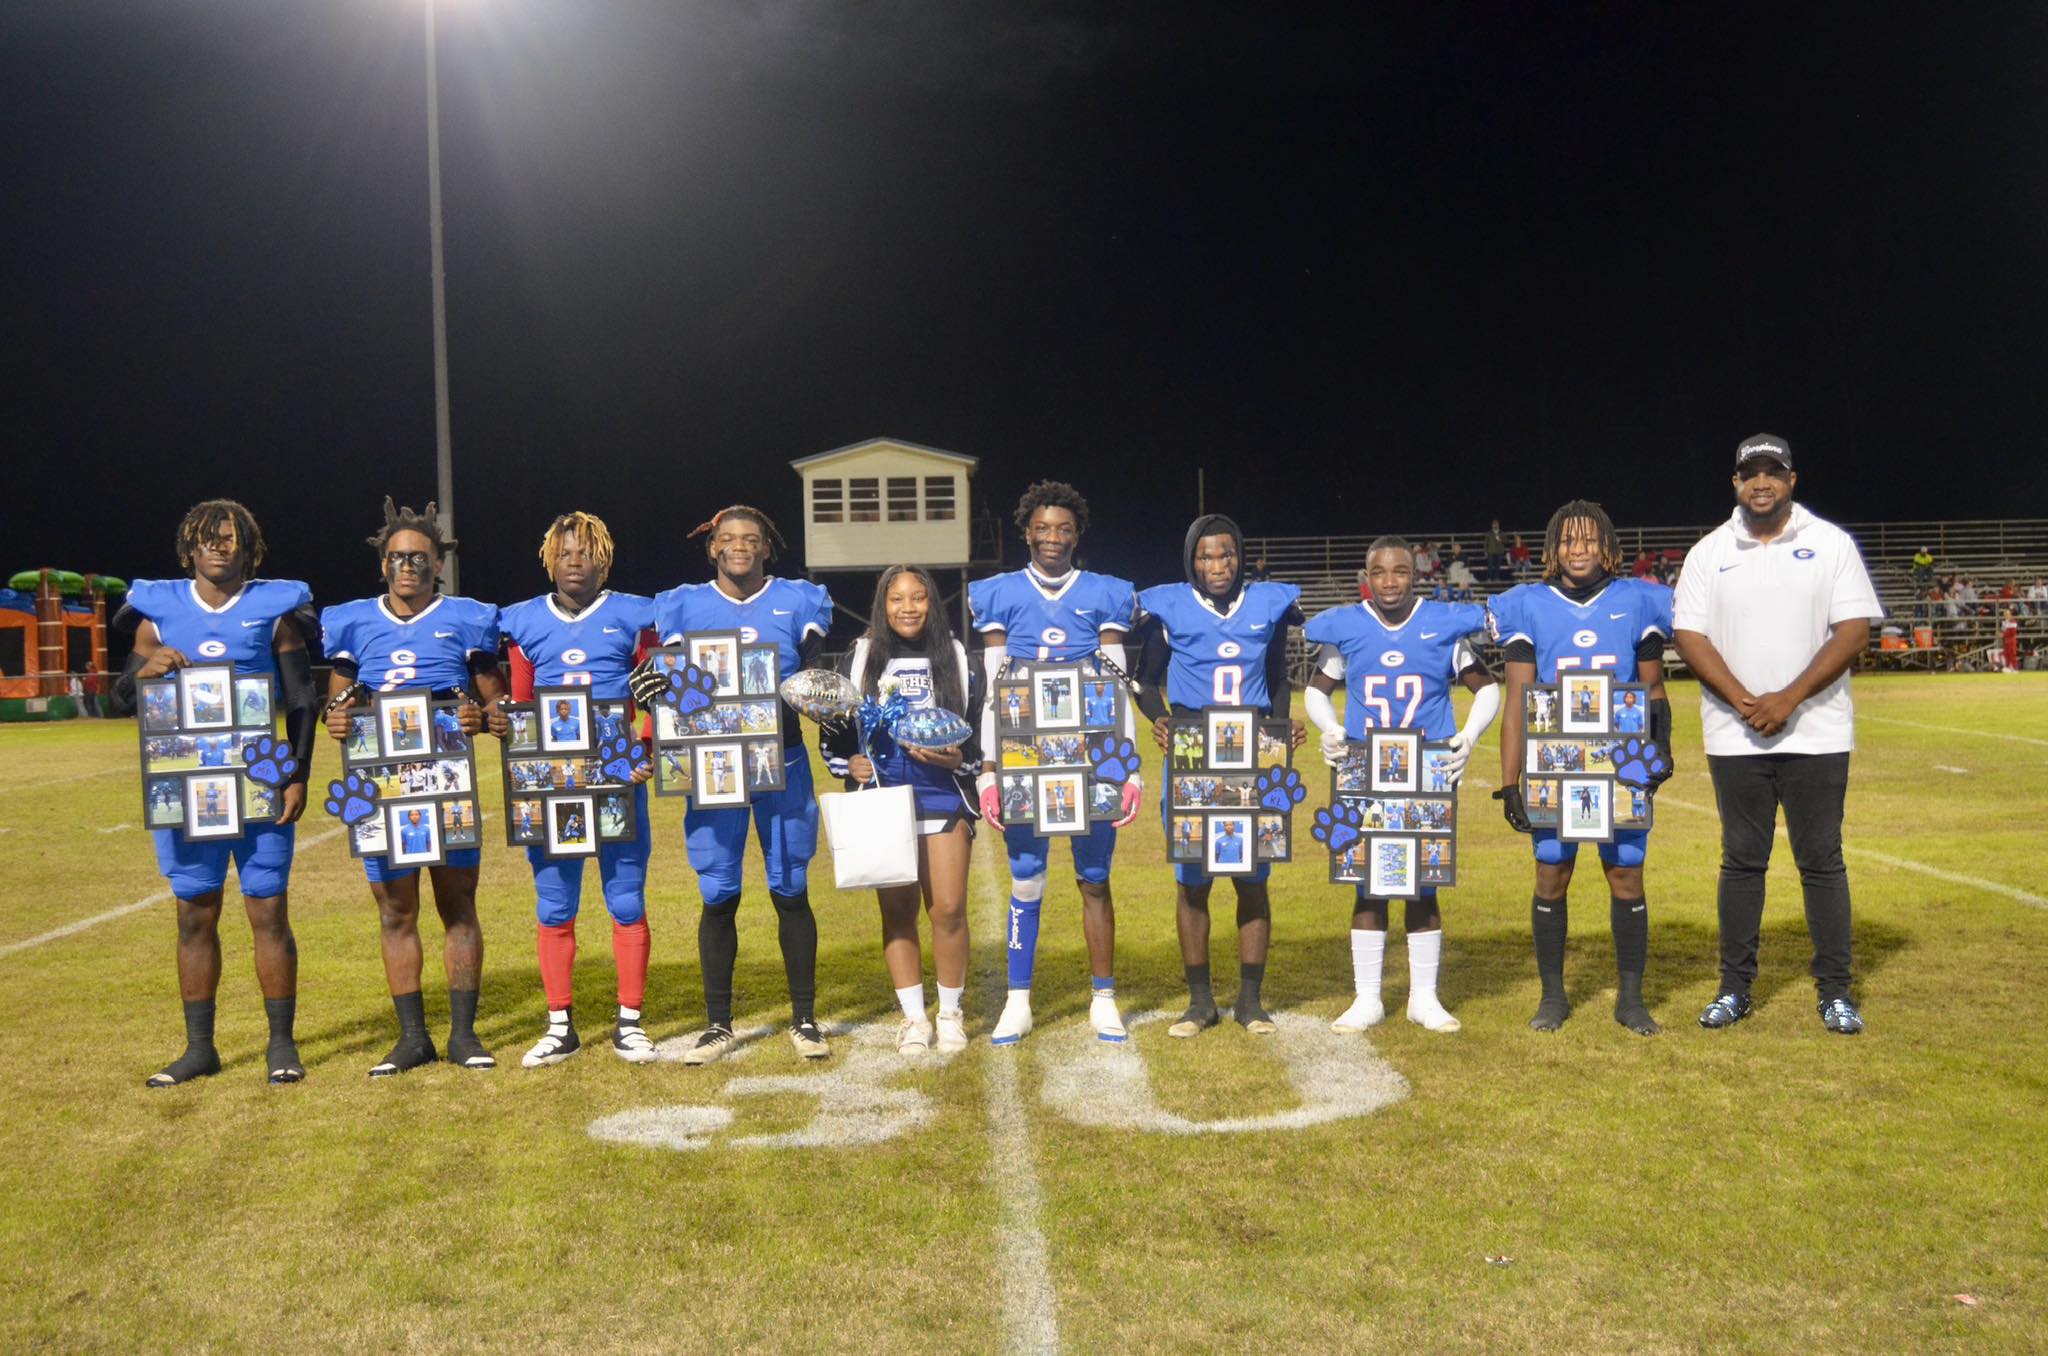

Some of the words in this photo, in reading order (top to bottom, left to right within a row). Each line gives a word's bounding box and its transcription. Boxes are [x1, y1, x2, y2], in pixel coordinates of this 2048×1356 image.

[1792, 548, 1815, 560] G
[1042, 627, 1066, 645] G
[1572, 629, 1598, 648] G
[198, 640, 227, 657] G
[390, 649, 417, 665] G
[561, 649, 587, 665] G
[1217, 641, 1241, 658] G
[1380, 650, 1405, 667] G
[1364, 674, 1424, 728] 52
